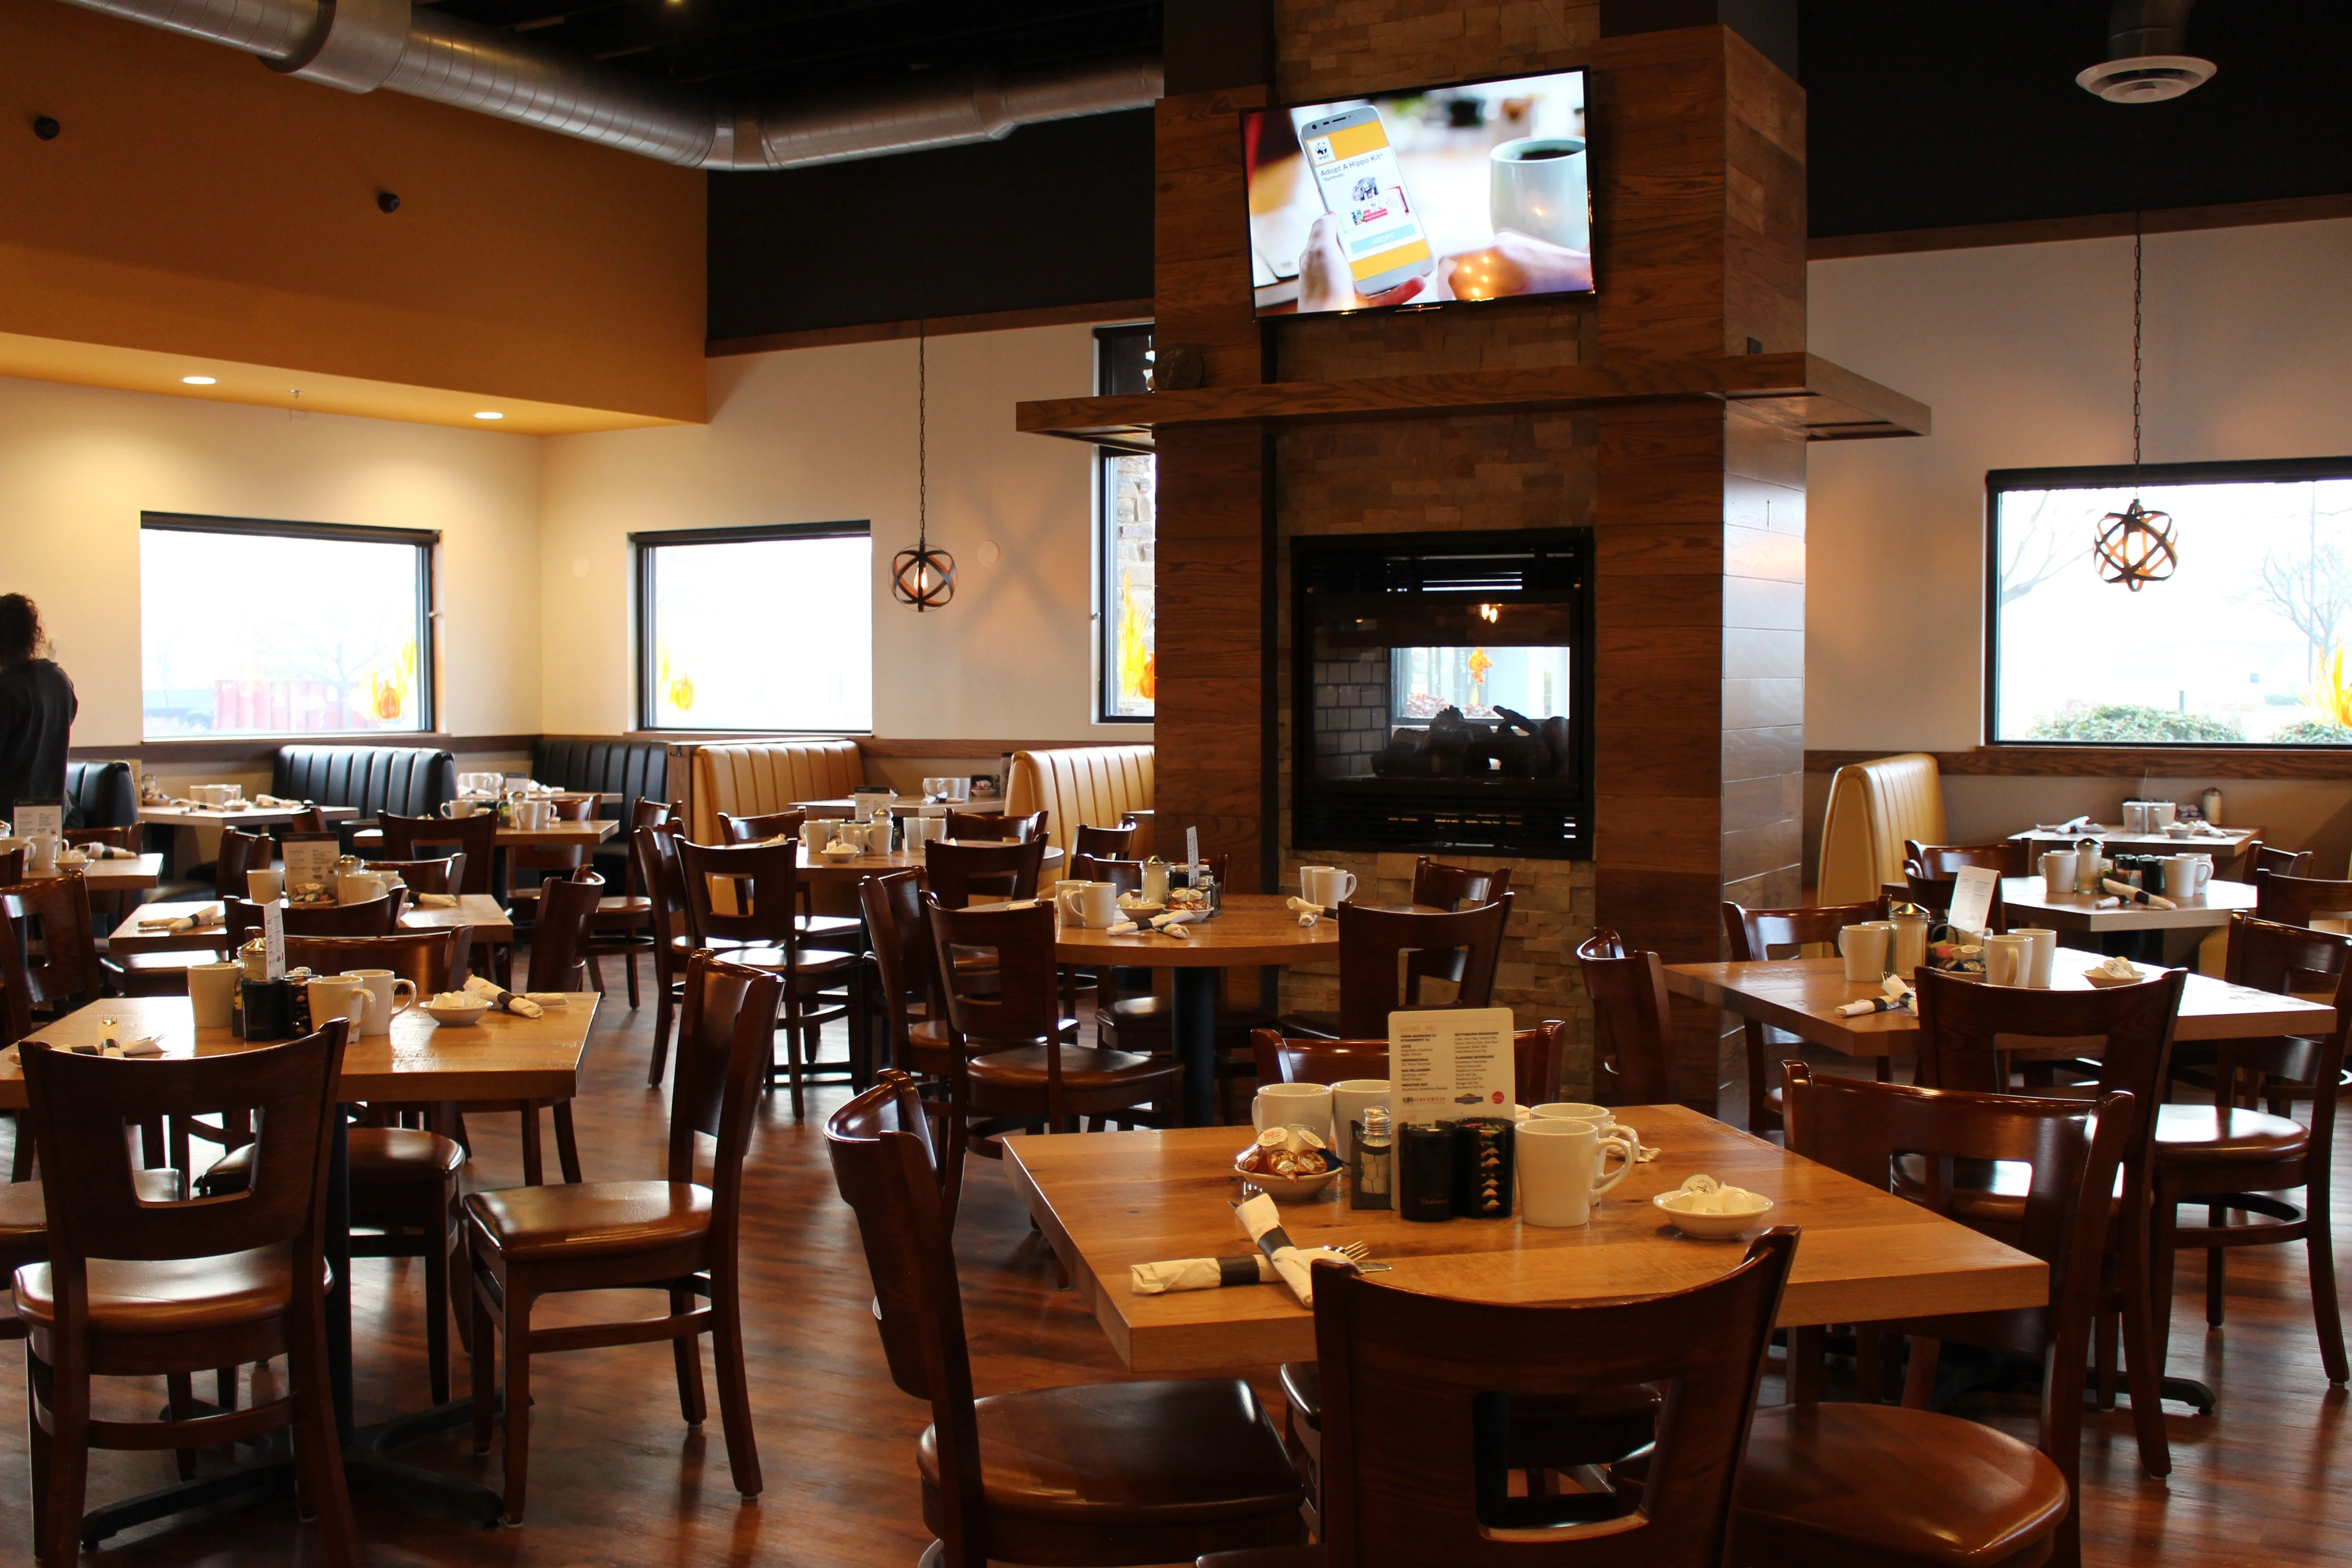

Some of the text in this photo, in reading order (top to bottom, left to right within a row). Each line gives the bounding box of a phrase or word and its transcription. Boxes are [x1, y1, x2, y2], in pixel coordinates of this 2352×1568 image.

[1320, 166, 1342, 177] Adopt
[1348, 158, 1369, 169] Hippo
[1372, 232, 1394, 245] ADOPT
